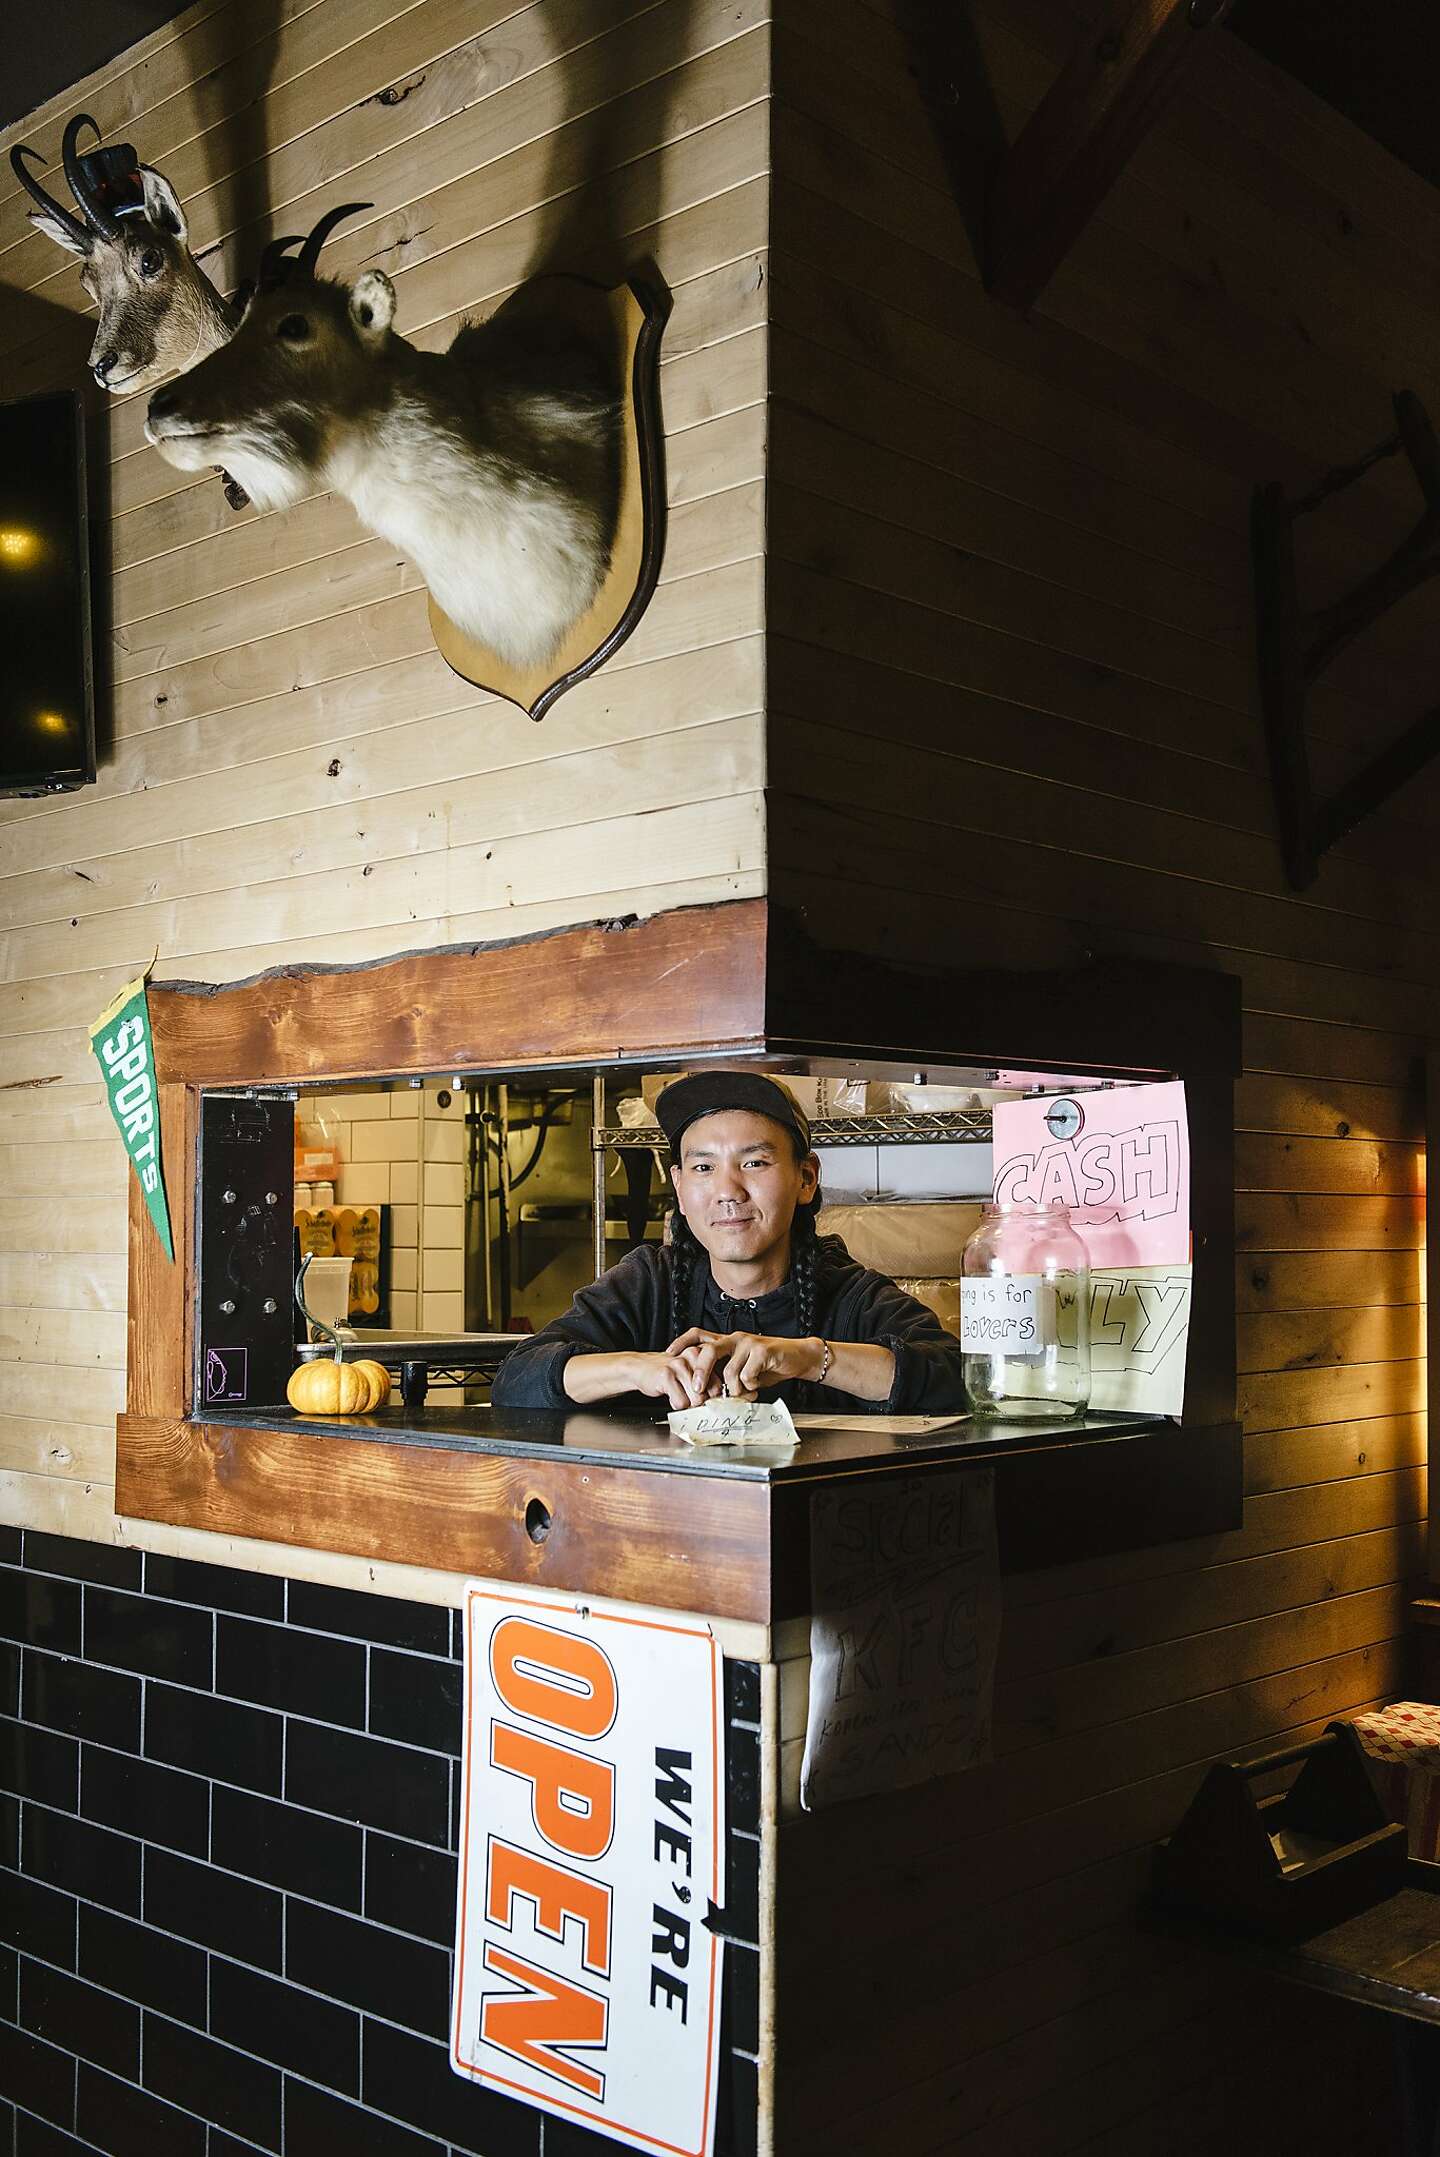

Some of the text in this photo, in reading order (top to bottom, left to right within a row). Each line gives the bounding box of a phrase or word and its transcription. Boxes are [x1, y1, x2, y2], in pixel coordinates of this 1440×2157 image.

[102, 1015, 158, 1194] SPORTS
[993, 1128, 1177, 1215] CASH
[982, 1283, 997, 1303] is
[1004, 1283, 1033, 1304] for
[834, 1584, 981, 1703] KFC
[479, 1615, 619, 2104] OPEN
[650, 1746, 693, 2026] WE'RE
